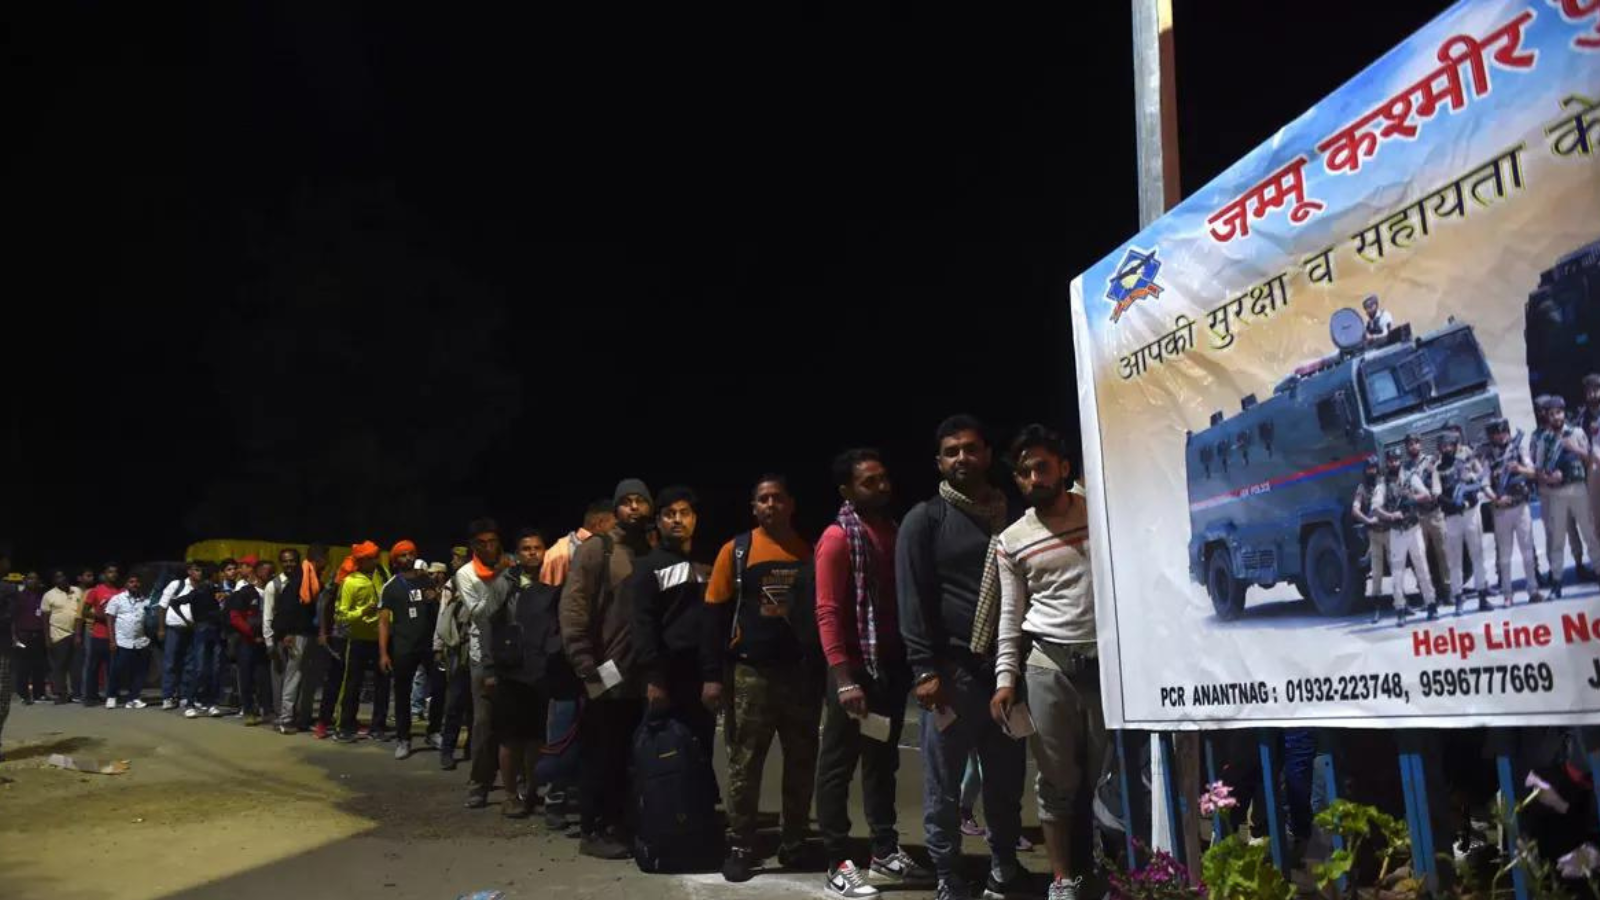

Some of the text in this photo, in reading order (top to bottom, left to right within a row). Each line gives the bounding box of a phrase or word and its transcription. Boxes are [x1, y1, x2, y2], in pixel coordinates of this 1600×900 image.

[1208, 11, 1535, 242] जम्मू कश्मीर
[1119, 314, 1196, 380] आपकी
[1207, 272, 1288, 349] सुरक्षा
[1303, 245, 1336, 284] व
[1351, 142, 1527, 262] सहायता
[1160, 686, 1186, 707] PCR
[1286, 672, 1410, 704] 01932-223748,
[1420, 661, 1553, 697] 9596777669
[1412, 627, 1475, 660] Help
[1484, 621, 1552, 651] Line
